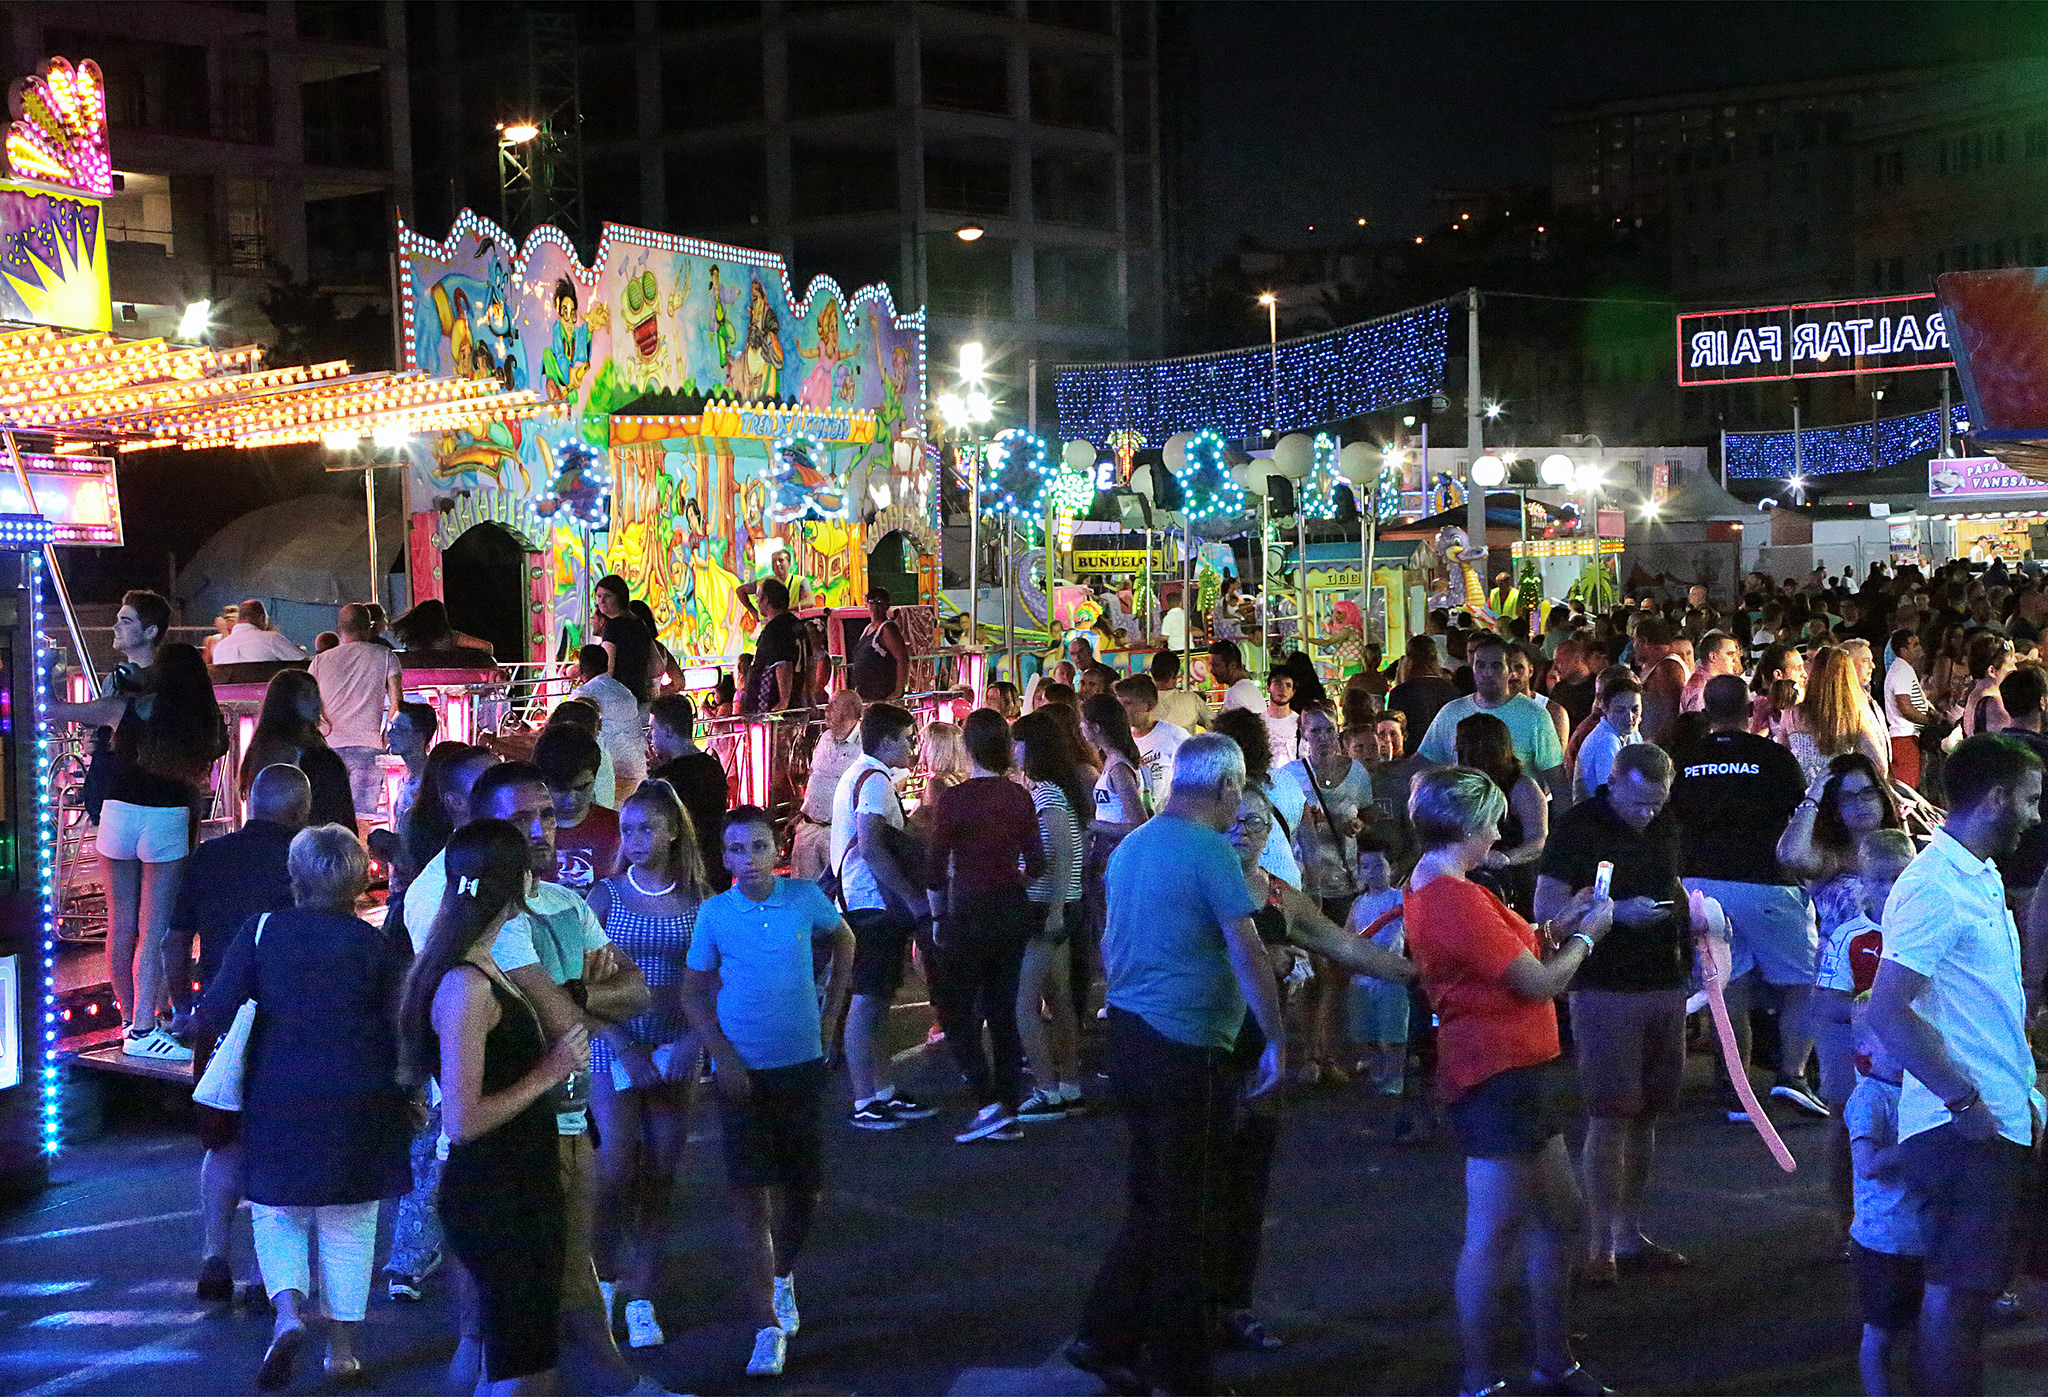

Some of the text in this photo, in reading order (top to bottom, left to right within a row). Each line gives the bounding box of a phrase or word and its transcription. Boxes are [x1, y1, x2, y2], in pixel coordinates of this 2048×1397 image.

[741, 411, 774, 437] TREN
[1966, 461, 2010, 477] PATAT
[1684, 762, 1760, 778] PETRONAS
